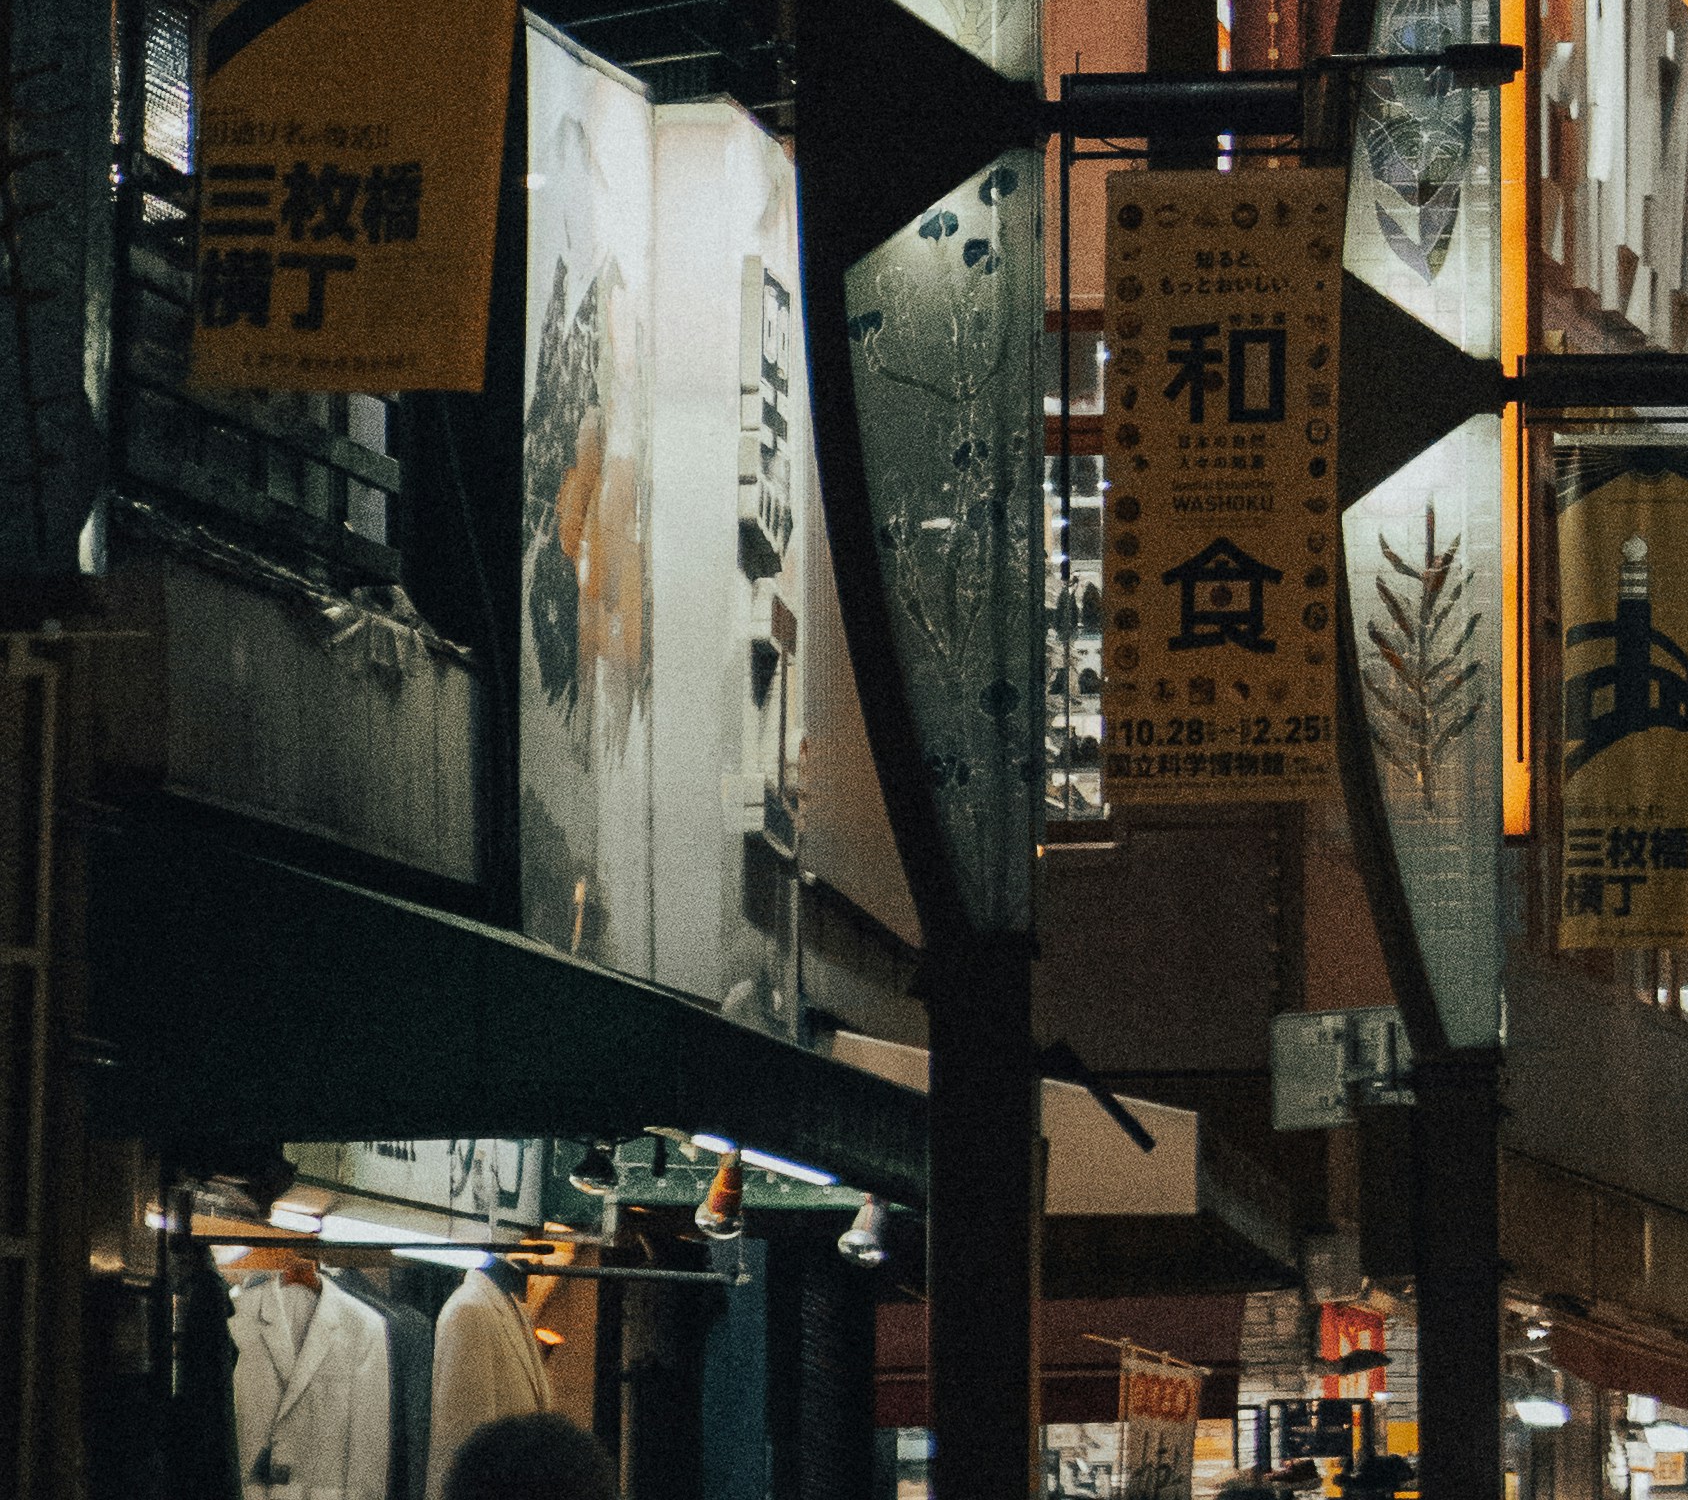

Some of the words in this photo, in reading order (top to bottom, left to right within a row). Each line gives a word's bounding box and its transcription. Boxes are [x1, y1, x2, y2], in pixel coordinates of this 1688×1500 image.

[204, 161, 422, 251] 三枚橋
[203, 250, 357, 330] 横丁
[1164, 322, 1286, 424] 和
[1172, 494, 1275, 513] WASHOKU
[1162, 536, 1284, 654] 食
[1120, 717, 1204, 747] 10.28
[1252, 714, 1322, 746] 2.25
[1107, 751, 1285, 778] 国立科学博物館
[1565, 874, 1648, 917] 横丁
